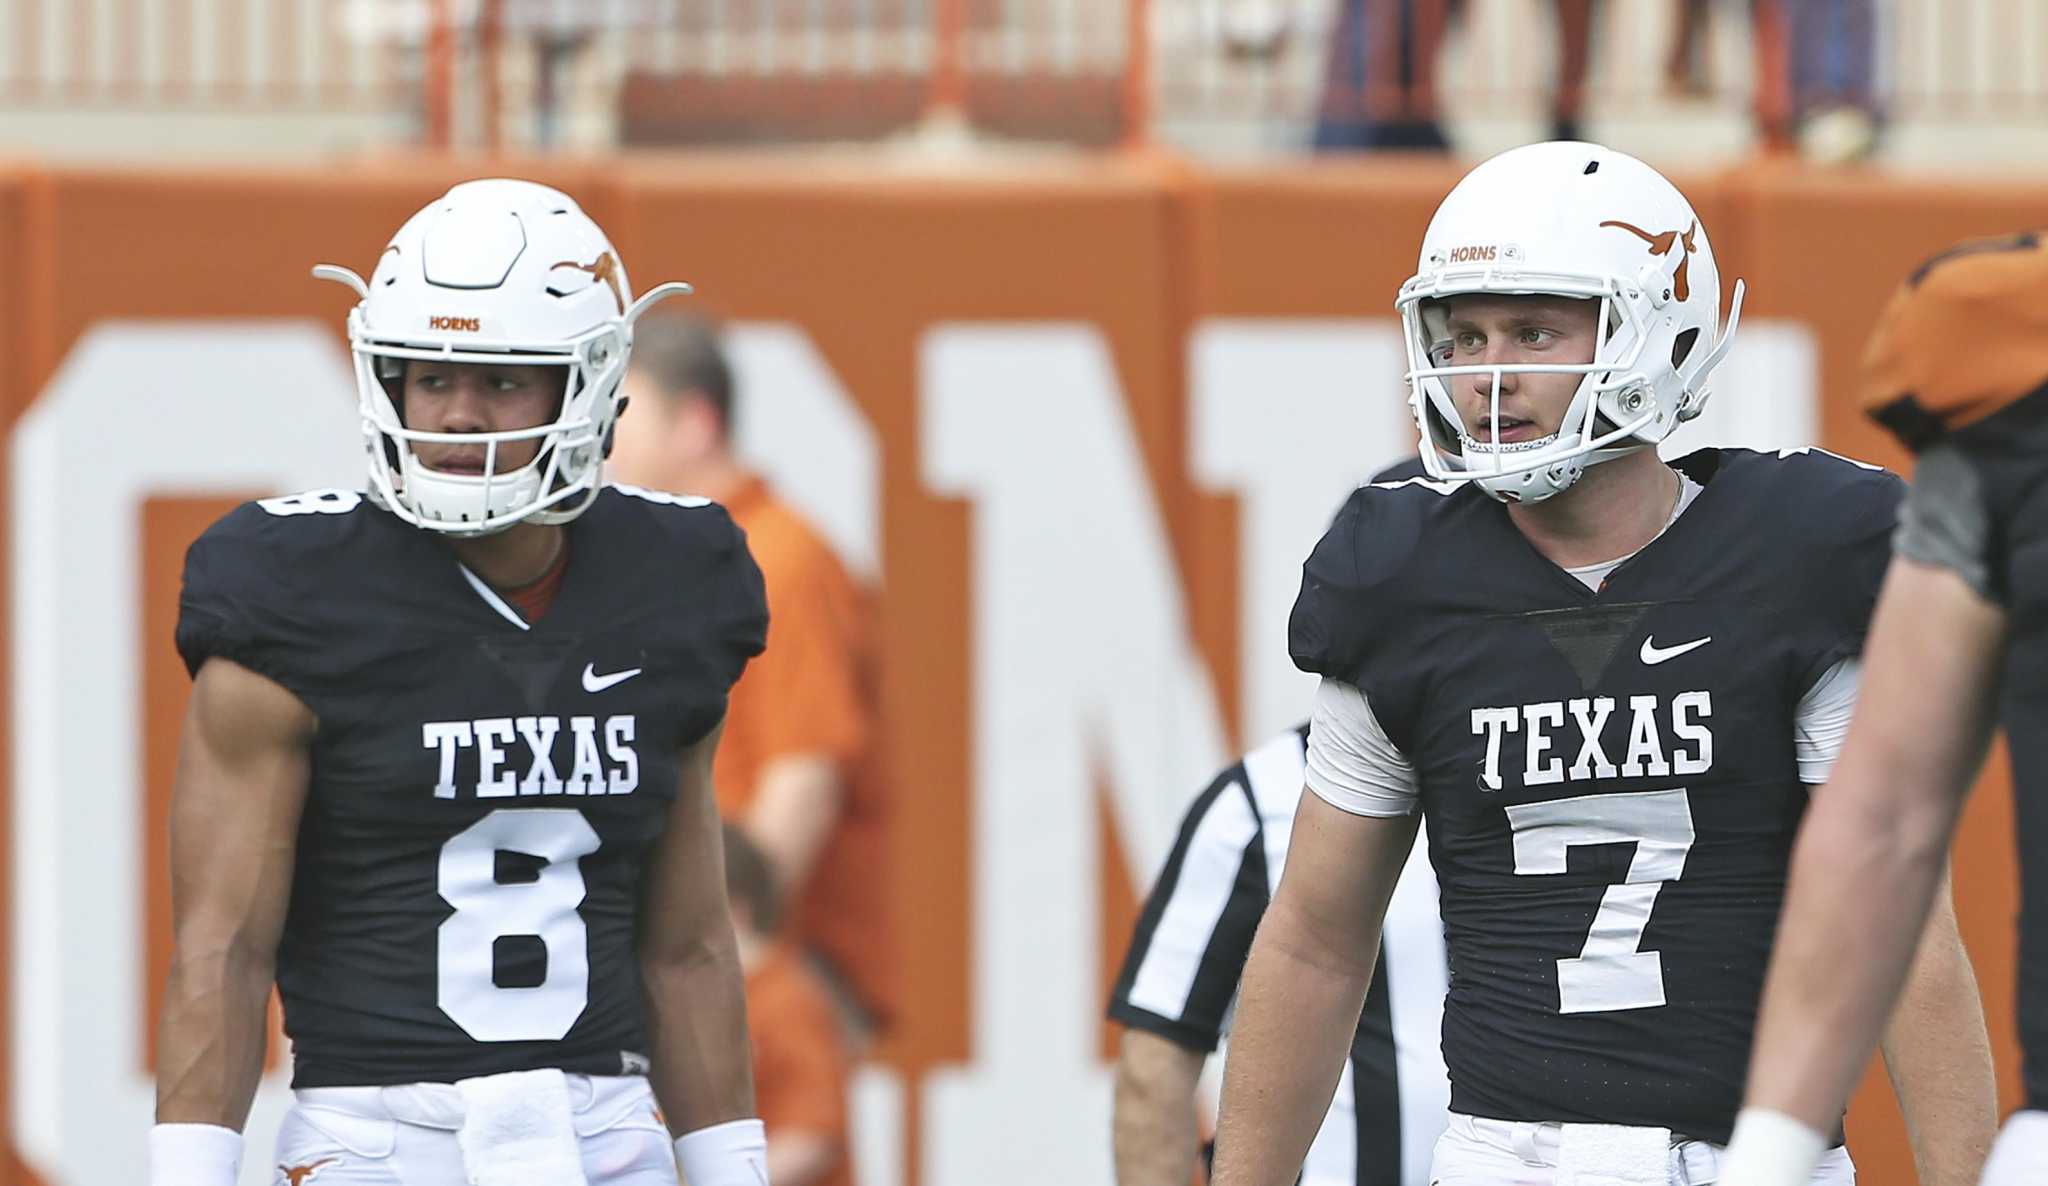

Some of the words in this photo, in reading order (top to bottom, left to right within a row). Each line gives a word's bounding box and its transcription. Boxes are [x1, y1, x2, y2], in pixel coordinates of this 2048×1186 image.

[1450, 245, 1497, 263] HORNS
[429, 315, 481, 332] HORNS
[422, 714, 640, 800] TEXAS
[1471, 691, 1713, 790] TEXAS
[437, 807, 602, 1042] 8
[1504, 787, 1696, 1014] 7
